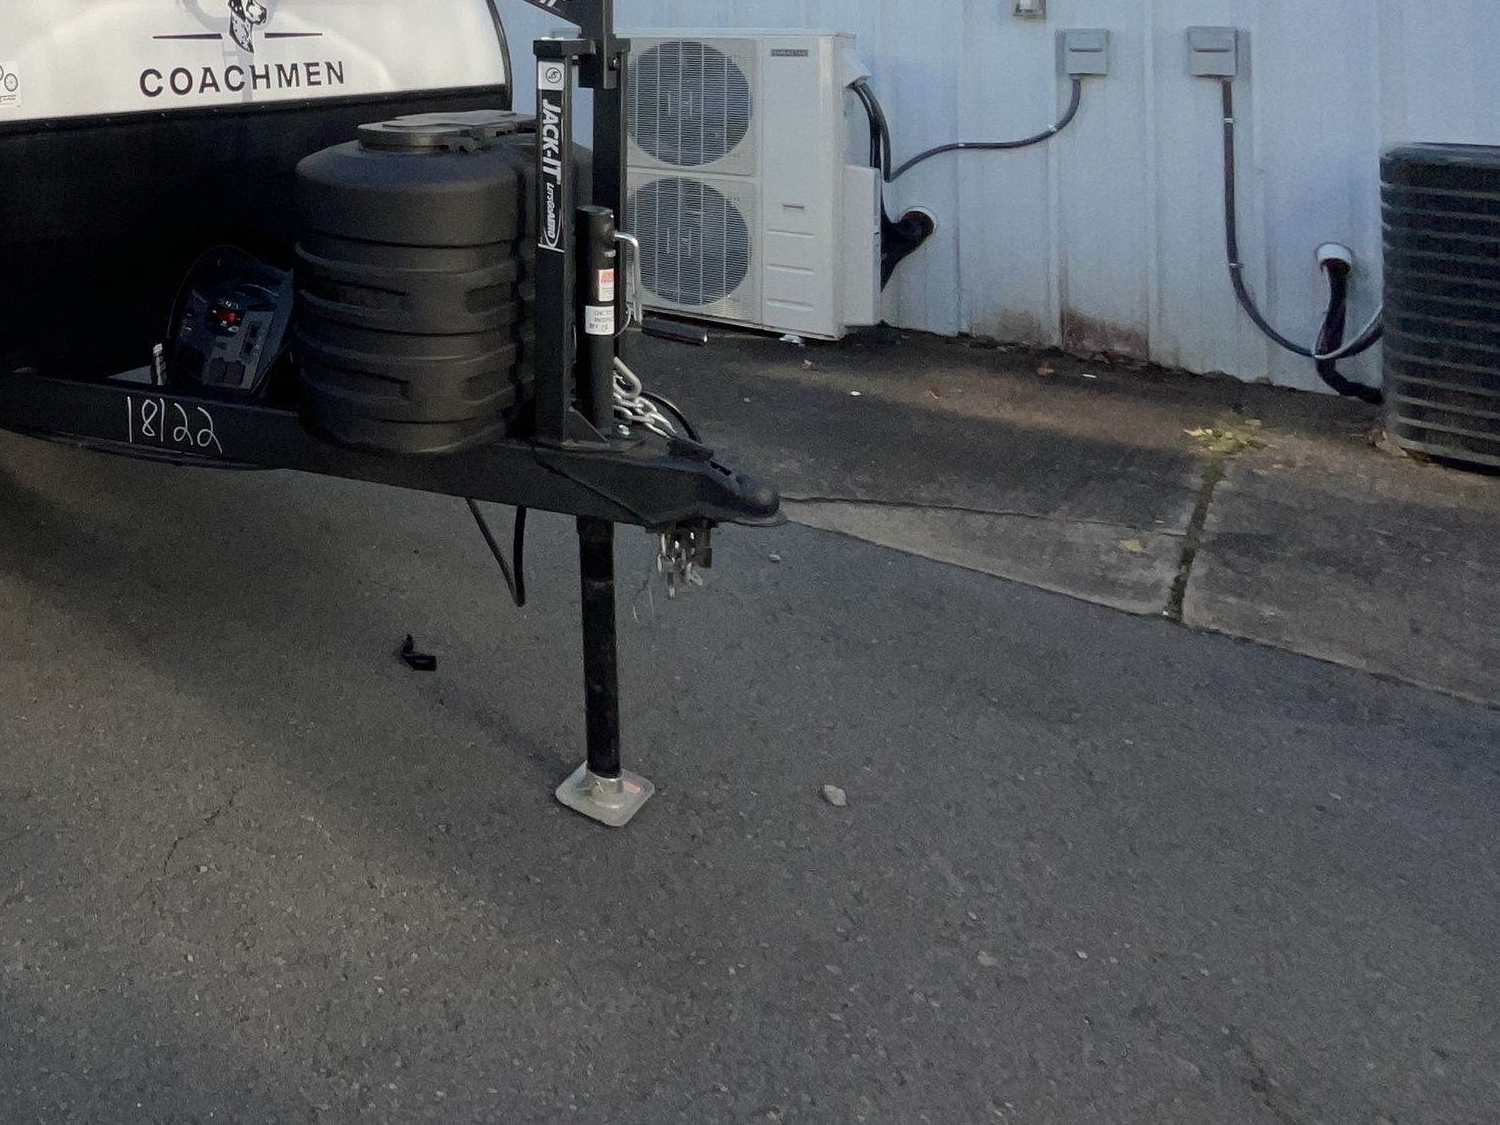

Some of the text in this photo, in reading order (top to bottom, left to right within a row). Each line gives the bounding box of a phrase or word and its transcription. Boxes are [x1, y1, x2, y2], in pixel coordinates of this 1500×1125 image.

[139, 60, 345, 98] COACHMEN
[542, 98, 562, 185] JACK-IT
[126, 395, 223, 455] 18122
